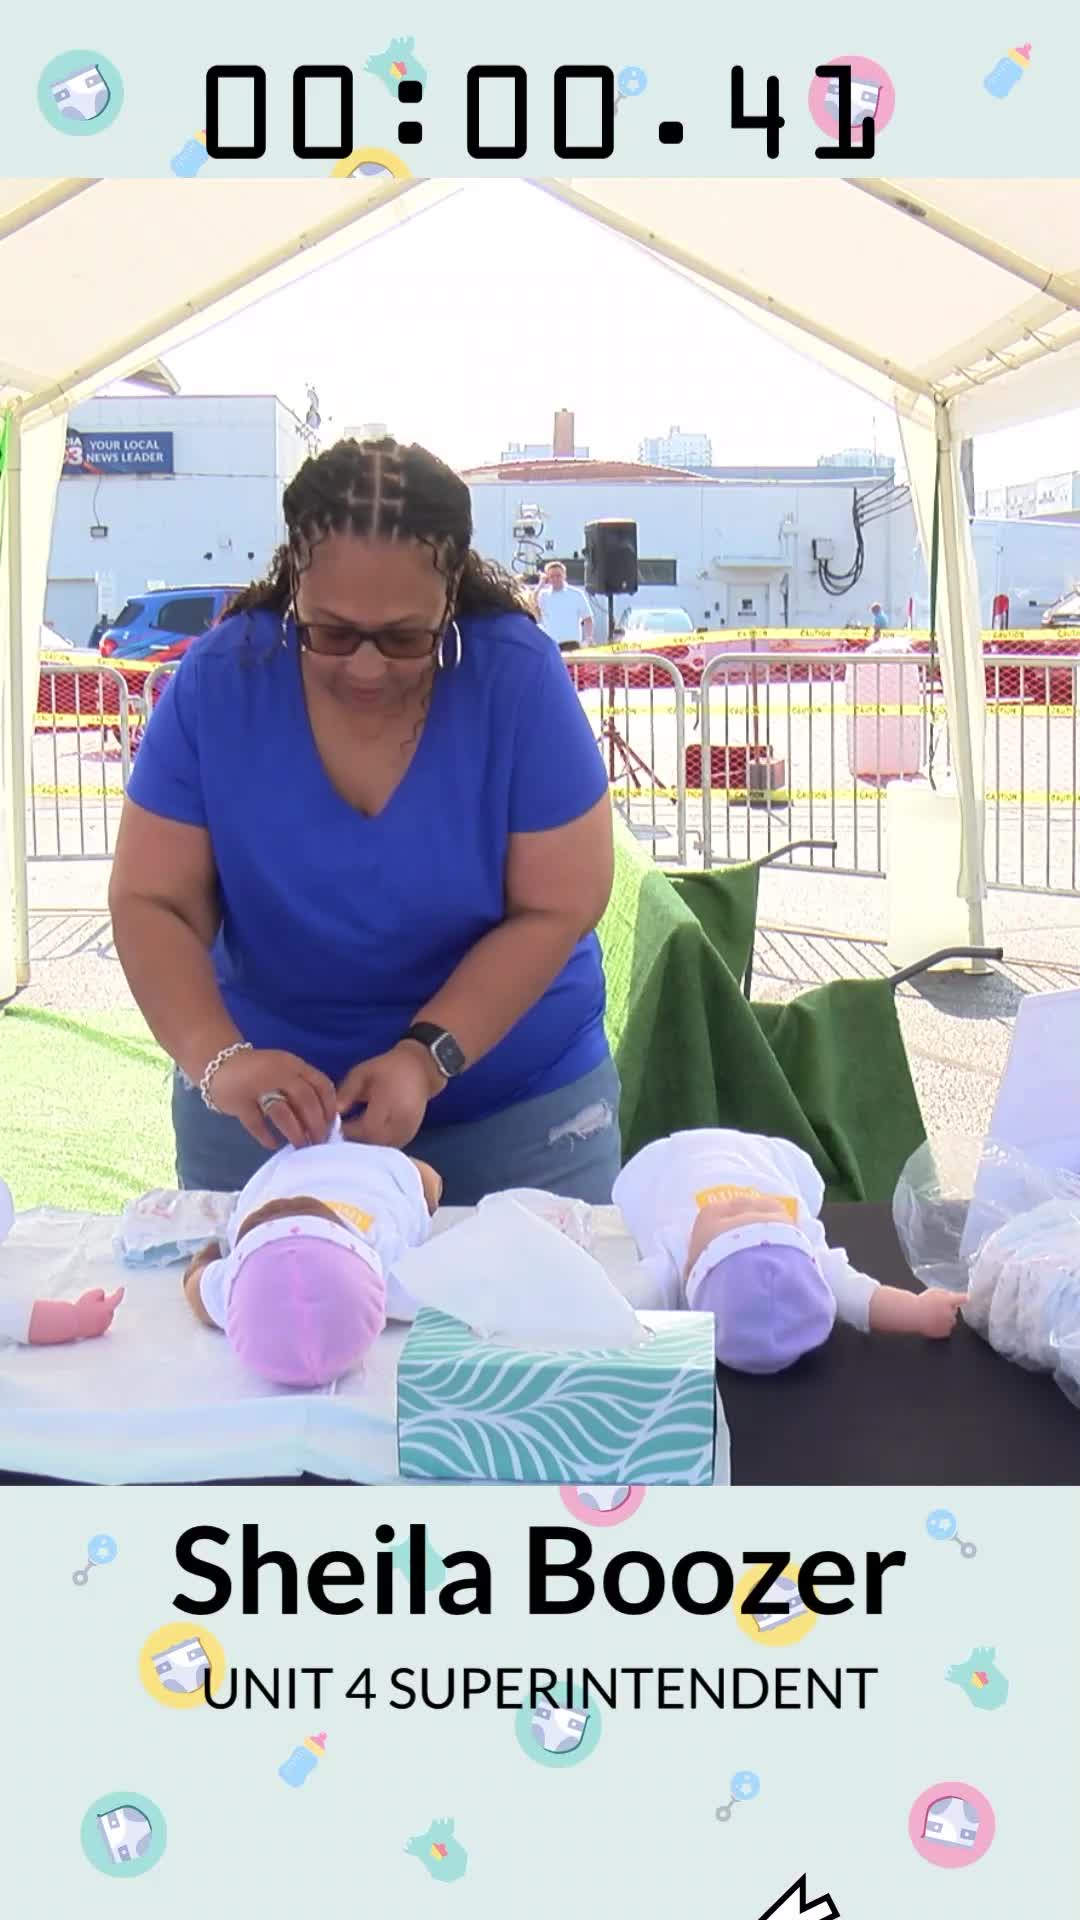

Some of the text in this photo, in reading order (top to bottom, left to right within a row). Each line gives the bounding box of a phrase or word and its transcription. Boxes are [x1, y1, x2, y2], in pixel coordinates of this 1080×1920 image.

[90, 439, 160, 451] YOUR LOCAL
[86, 451, 164, 463] NEWS LEADER
[800, 629, 832, 638] CAUTION
[992, 631, 1025, 639] CAUTION
